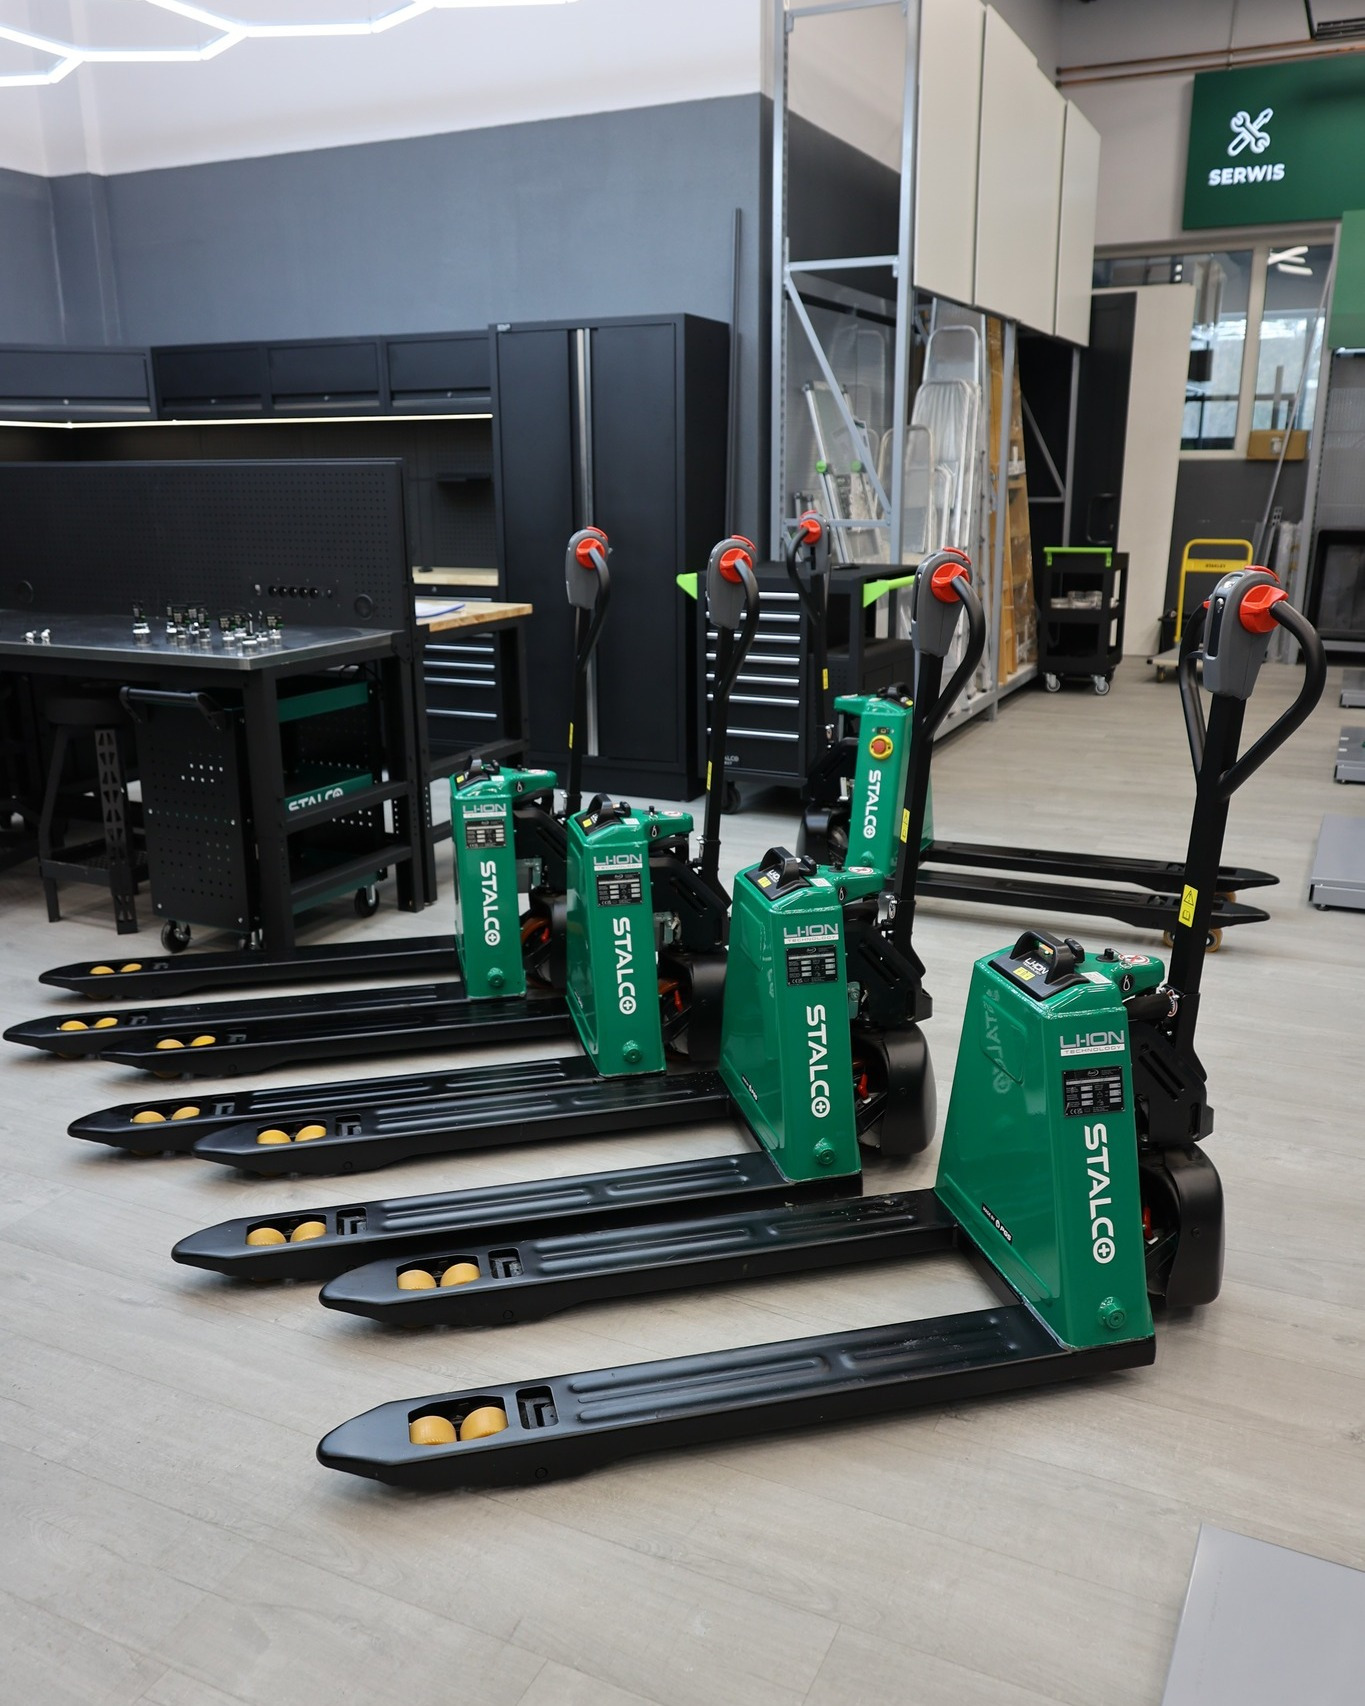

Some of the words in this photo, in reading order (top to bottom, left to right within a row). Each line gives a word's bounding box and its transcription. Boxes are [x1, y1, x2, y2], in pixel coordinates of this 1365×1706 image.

[1208, 163, 1285, 186] SERWIS
[864, 769, 882, 839] STALCO
[480, 860, 501, 946] STALCO
[613, 917, 637, 1015] STALCO
[806, 1004, 831, 1118] STALCO
[1063, 1045, 1121, 1055] TECHNOLOGY
[1084, 1123, 1116, 1264] STALCO
